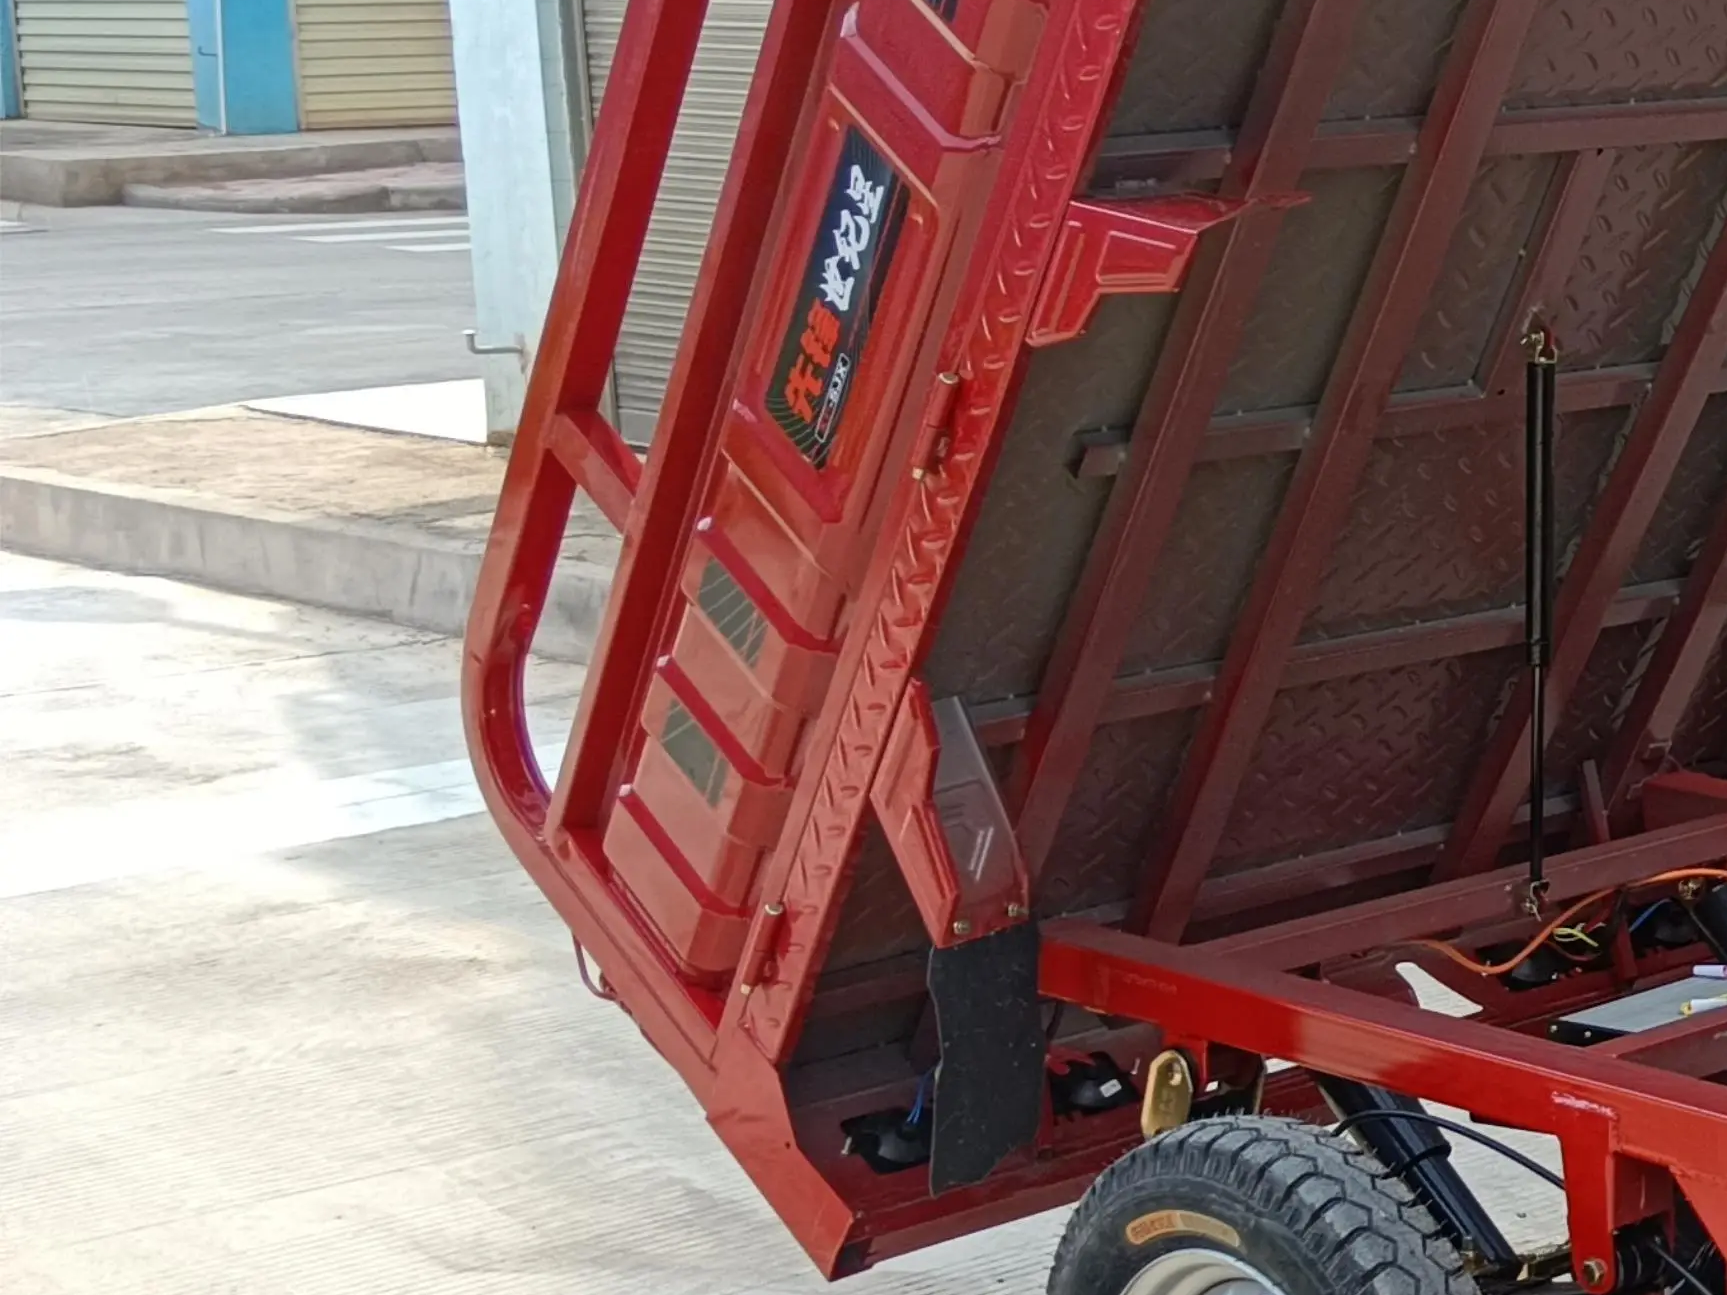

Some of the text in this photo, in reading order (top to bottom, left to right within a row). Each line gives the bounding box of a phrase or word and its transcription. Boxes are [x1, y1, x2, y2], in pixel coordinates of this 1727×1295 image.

[784, 164, 885, 422] 先锋世纪星
